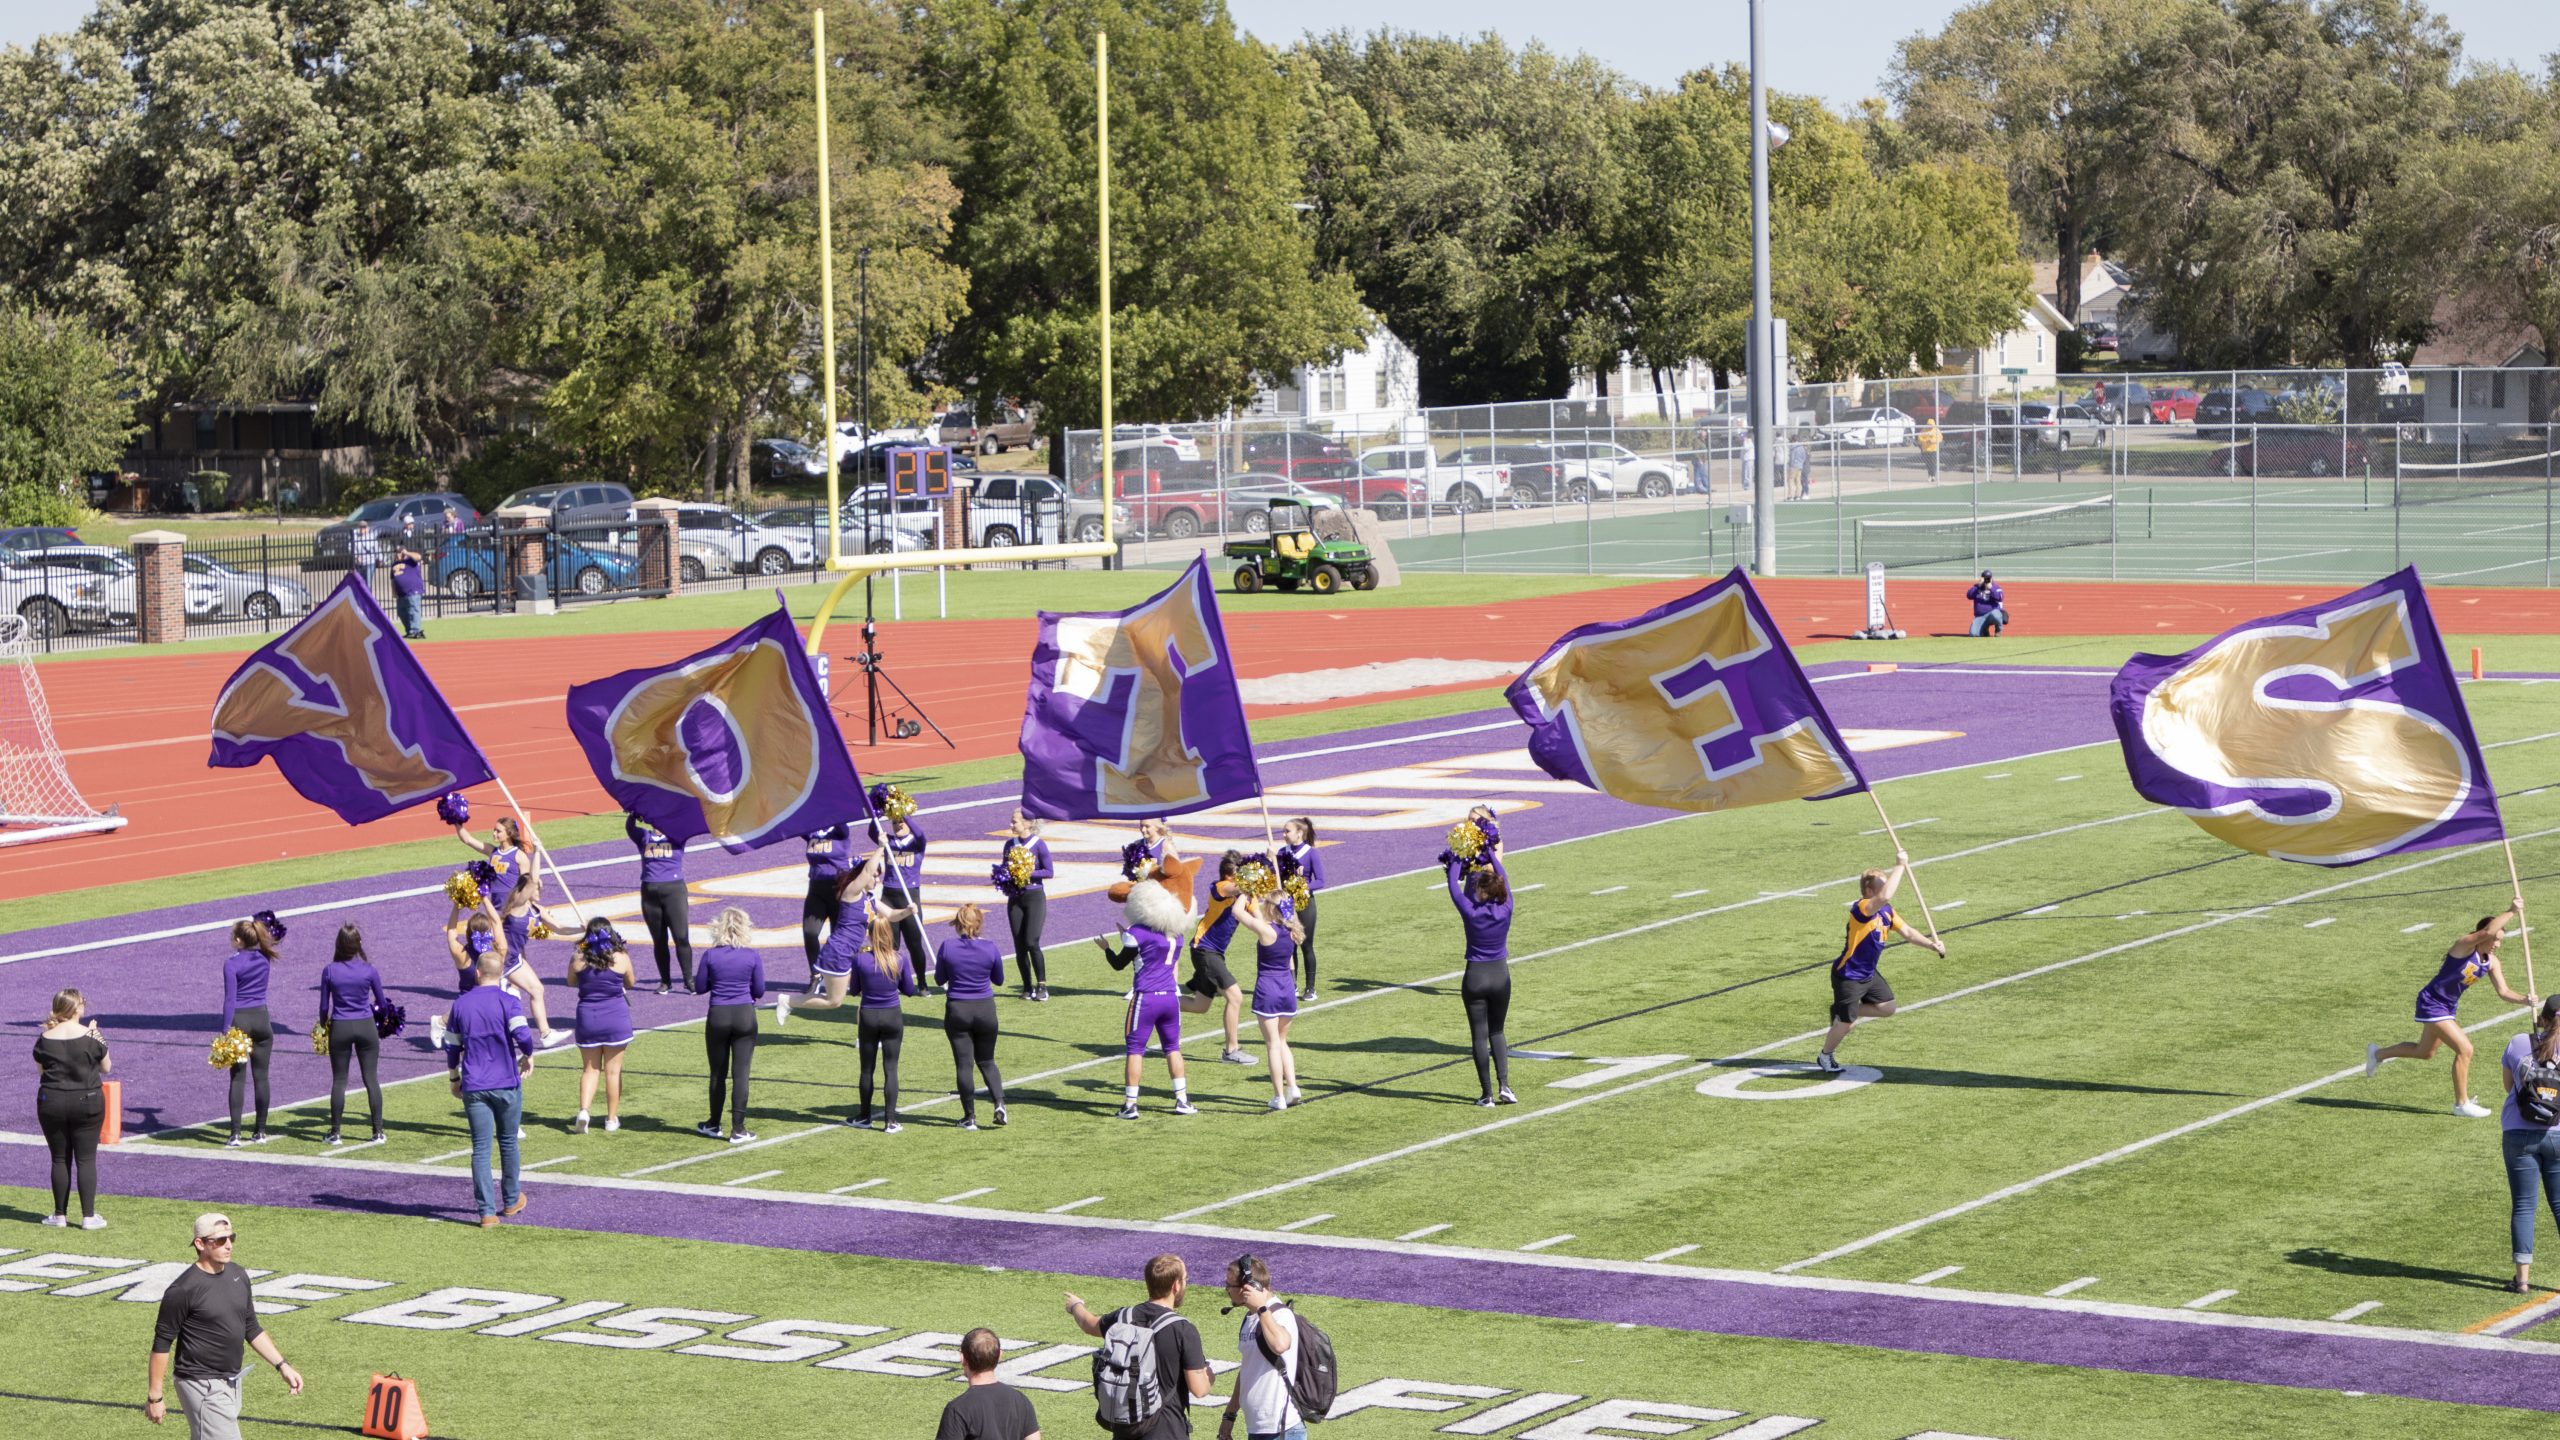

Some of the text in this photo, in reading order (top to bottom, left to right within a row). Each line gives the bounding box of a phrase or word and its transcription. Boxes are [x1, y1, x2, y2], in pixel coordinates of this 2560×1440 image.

[895, 452, 948, 493] 25
[211, 587, 458, 804] Y
[604, 637, 820, 846] O
[1053, 563, 1218, 813] T
[1525, 583, 1858, 812] E
[2142, 589, 2472, 865] S
[0, 1248, 405, 1316] ENE
[371, 1382, 402, 1432] 10
